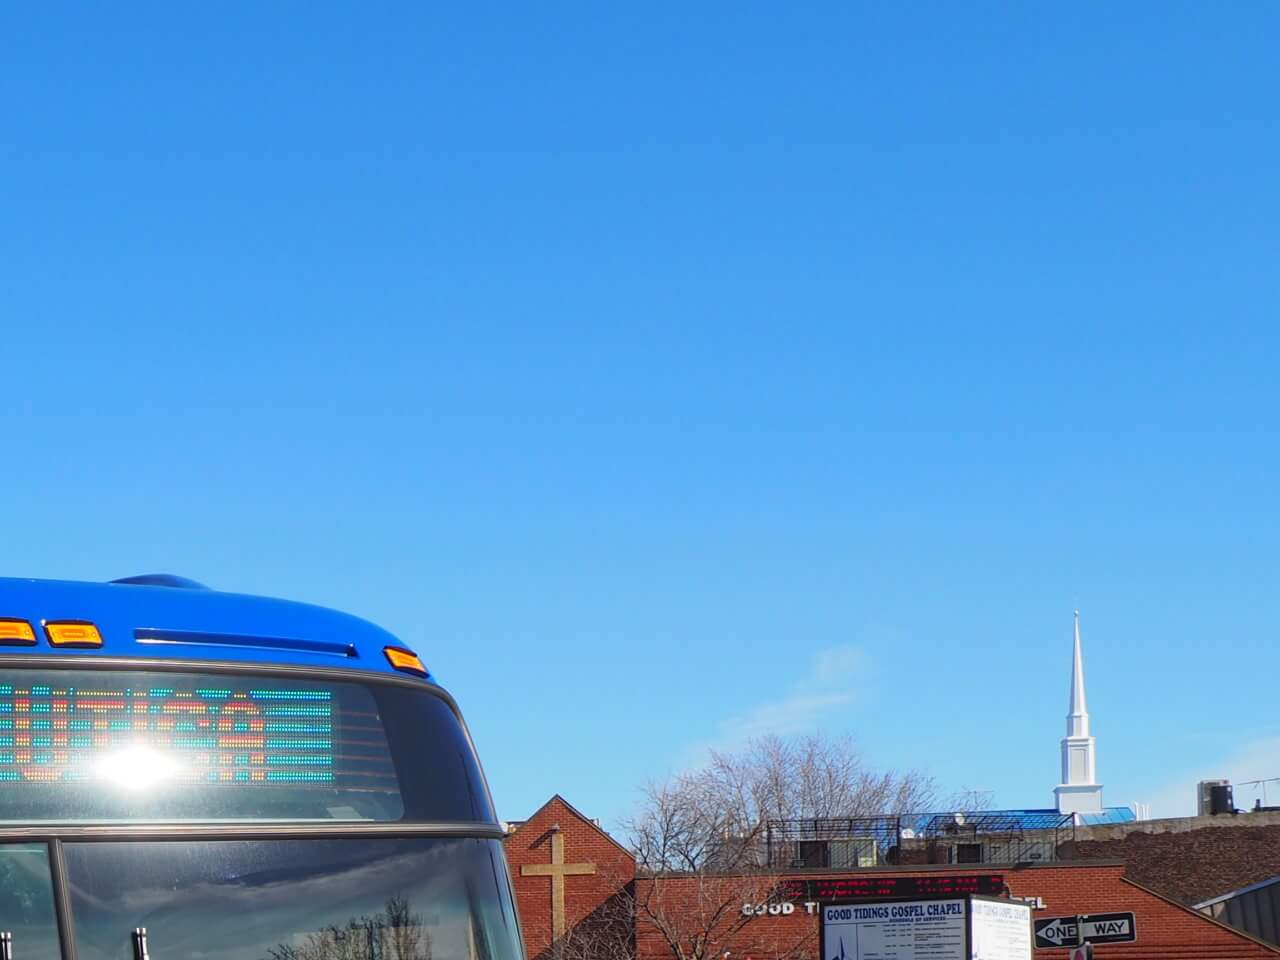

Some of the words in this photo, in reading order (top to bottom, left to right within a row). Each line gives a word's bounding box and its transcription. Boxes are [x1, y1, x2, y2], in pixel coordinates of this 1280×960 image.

[827, 908, 852, 920] GOOD
[853, 906, 889, 919] TIDINGS
[891, 904, 925, 918] GOSPEL
[927, 903, 962, 916] CHAPEL
[1045, 925, 1078, 939] ONE
[1094, 921, 1125, 935] WAY
